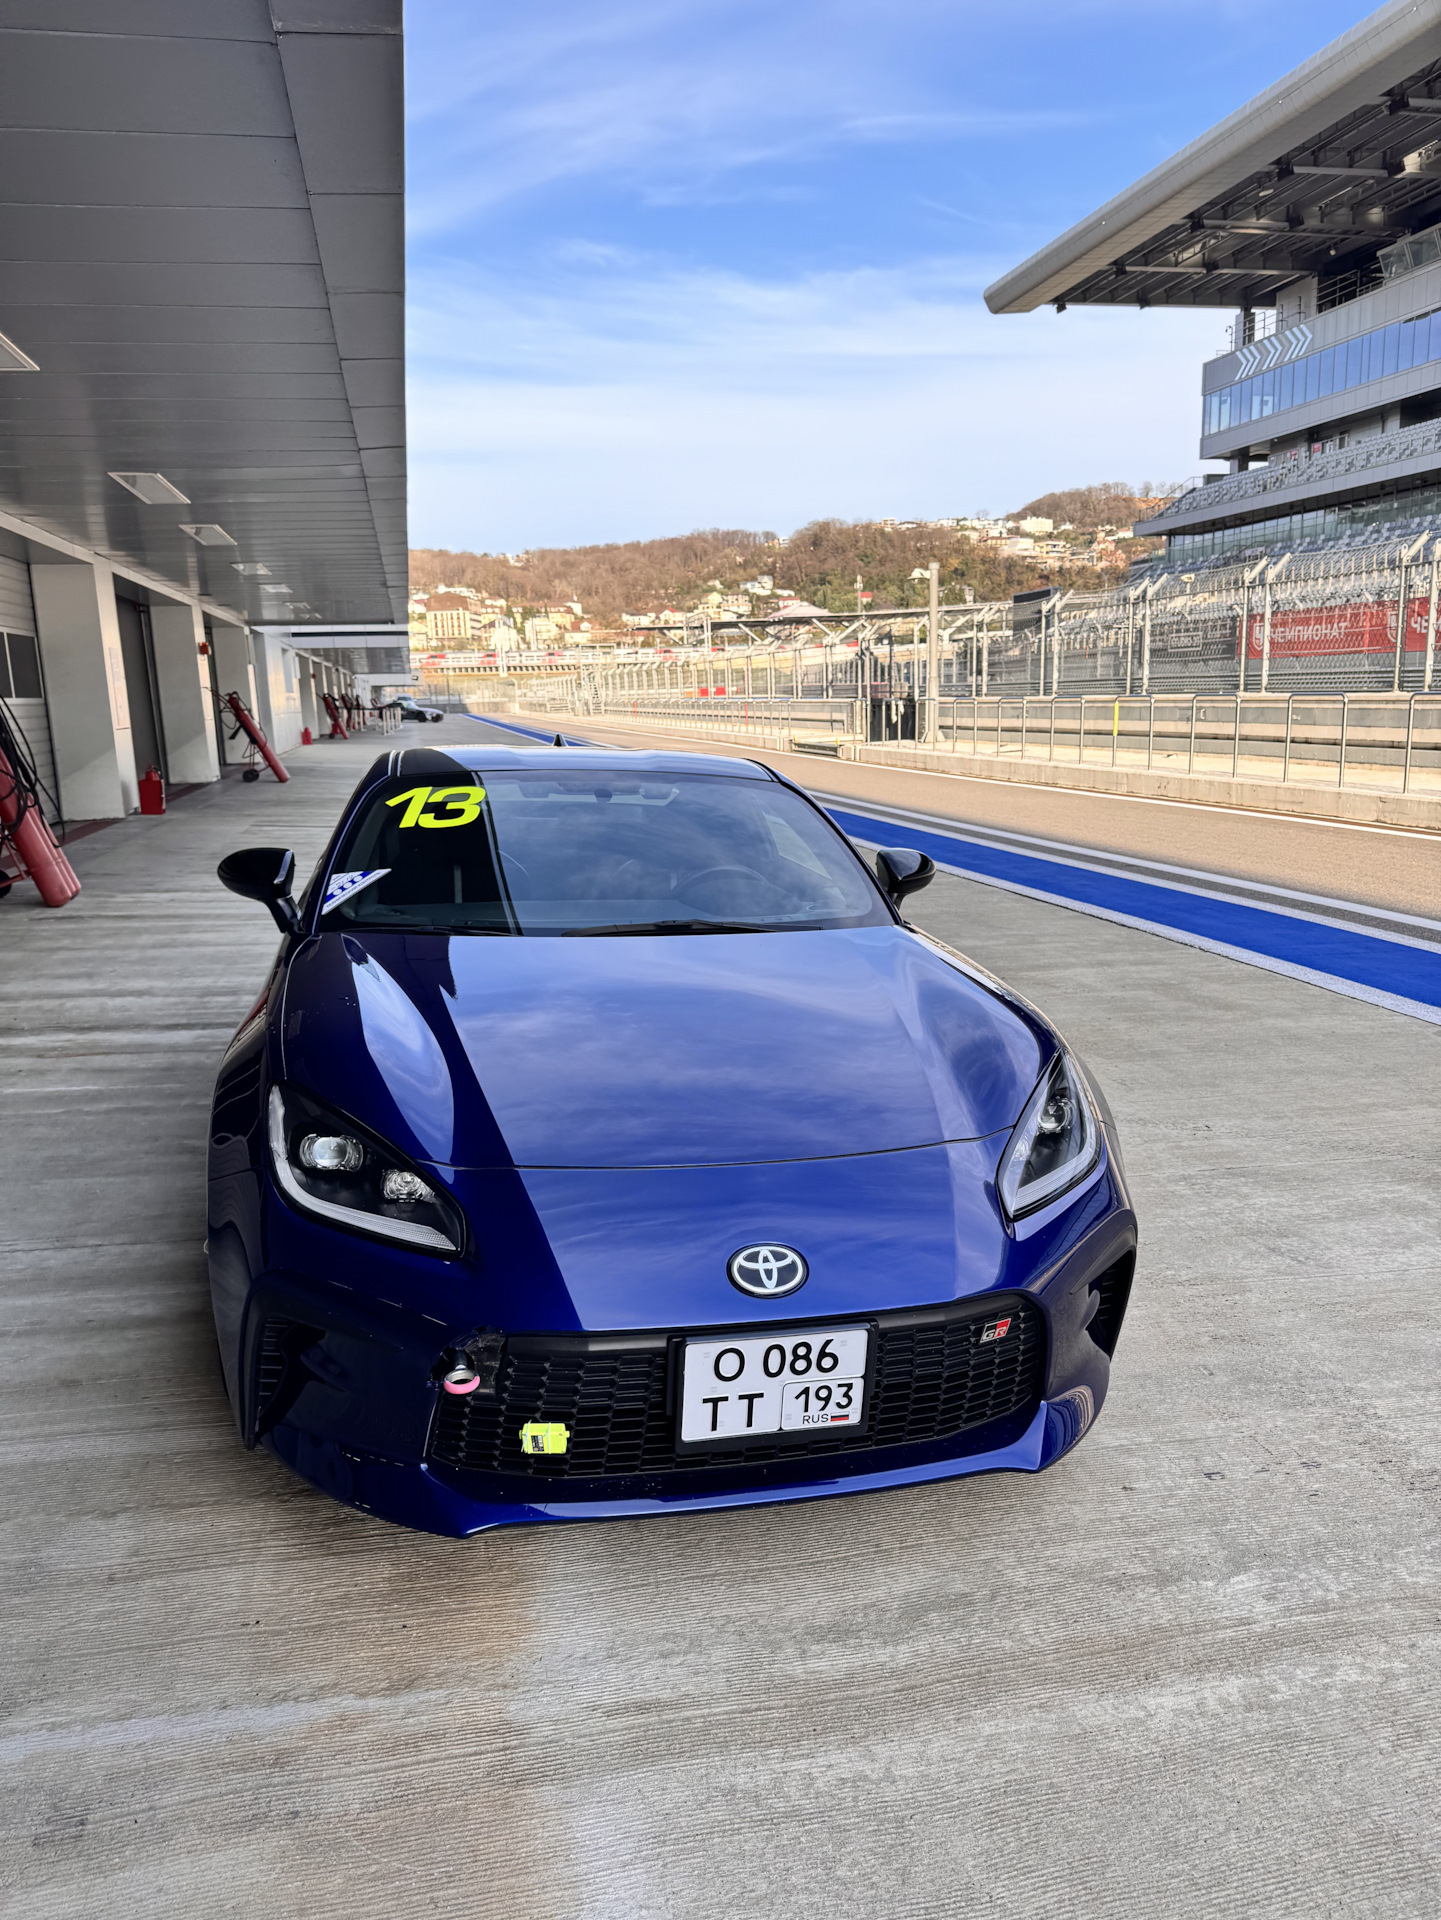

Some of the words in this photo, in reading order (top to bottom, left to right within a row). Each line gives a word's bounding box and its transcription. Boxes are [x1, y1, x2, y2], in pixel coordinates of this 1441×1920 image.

[1270, 622, 1349, 643] ЧЕМПИОНАТ
[385, 786, 487, 829] 13
[982, 1326, 1007, 1340] GR
[763, 1338, 839, 1378] 086
[795, 1382, 853, 1413] 193
[803, 1413, 829, 1425] RUS
